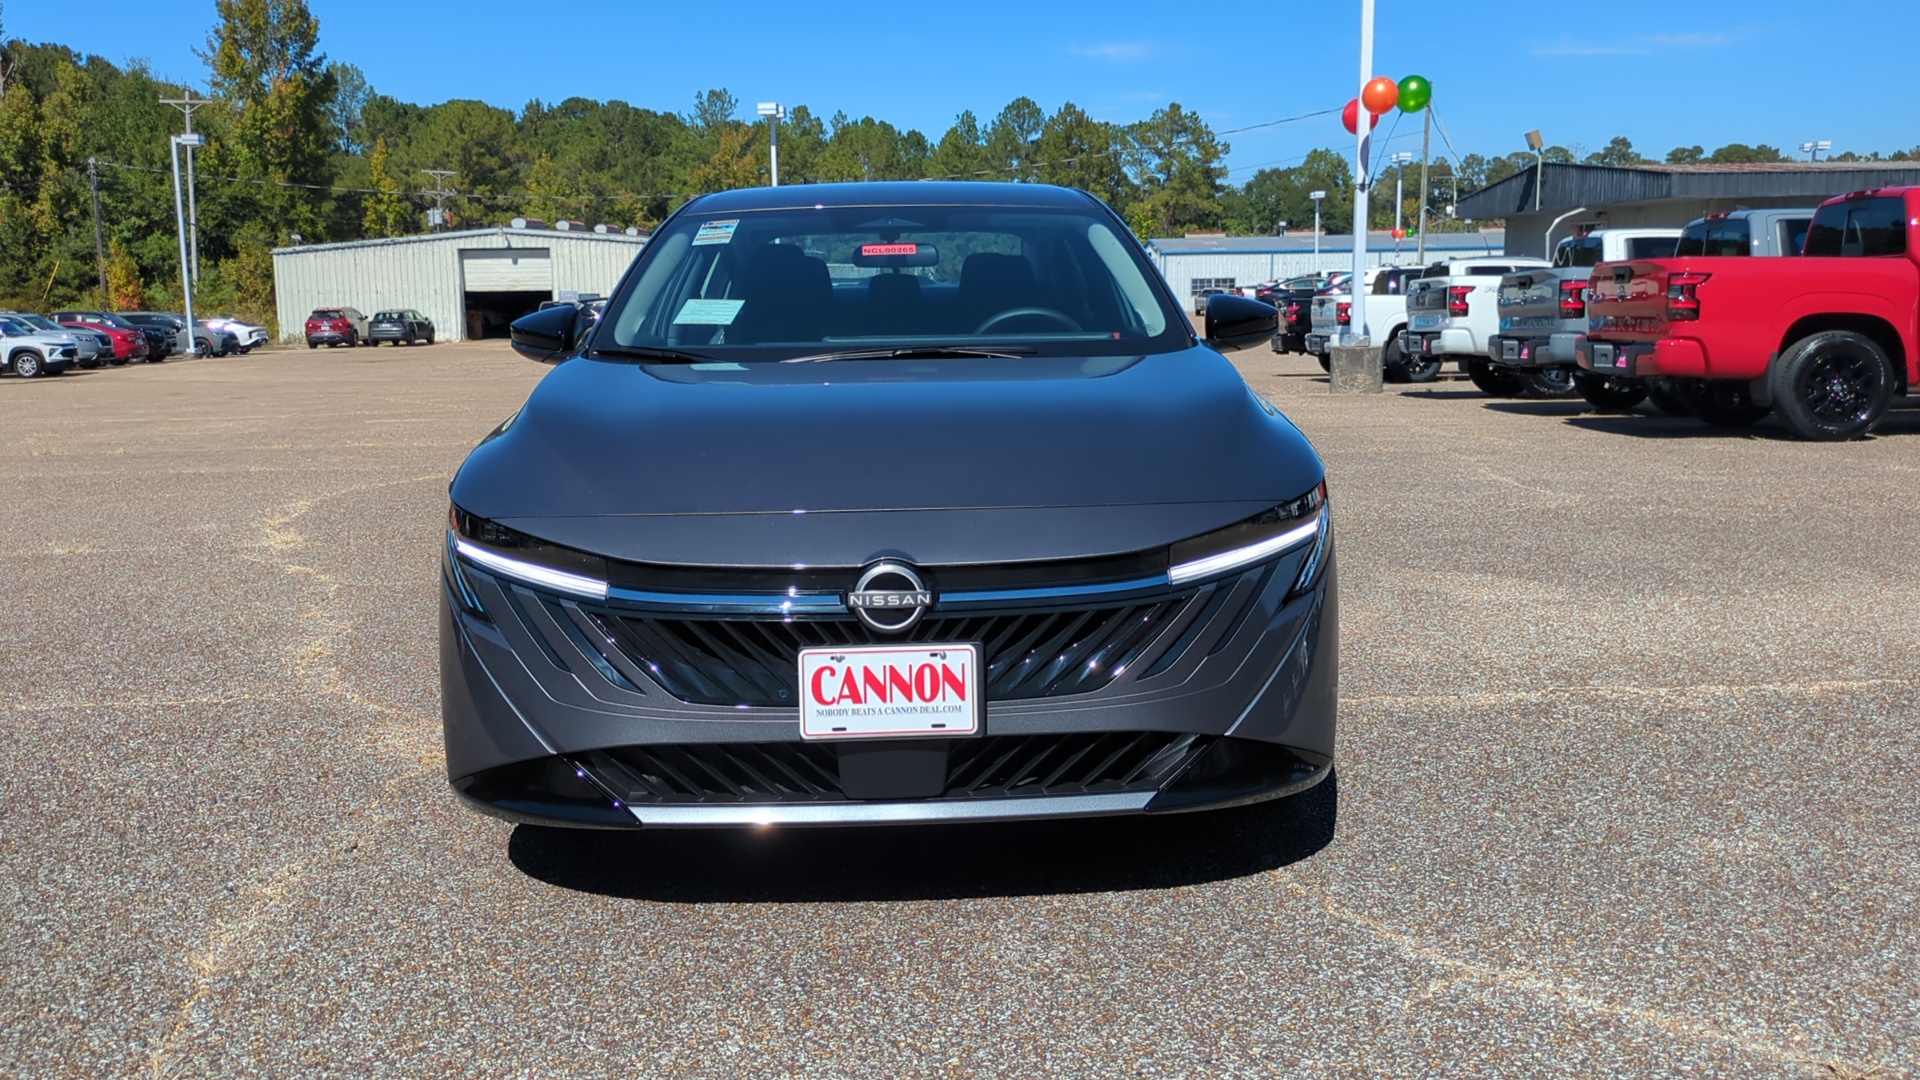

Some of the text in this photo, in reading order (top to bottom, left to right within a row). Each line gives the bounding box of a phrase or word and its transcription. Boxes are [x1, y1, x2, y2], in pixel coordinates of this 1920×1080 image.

[850, 593, 931, 606] NISSAN
[811, 663, 965, 705] CANNON
[816, 704, 962, 717] NOBODY BEATS A CANNON DEAL.COM
